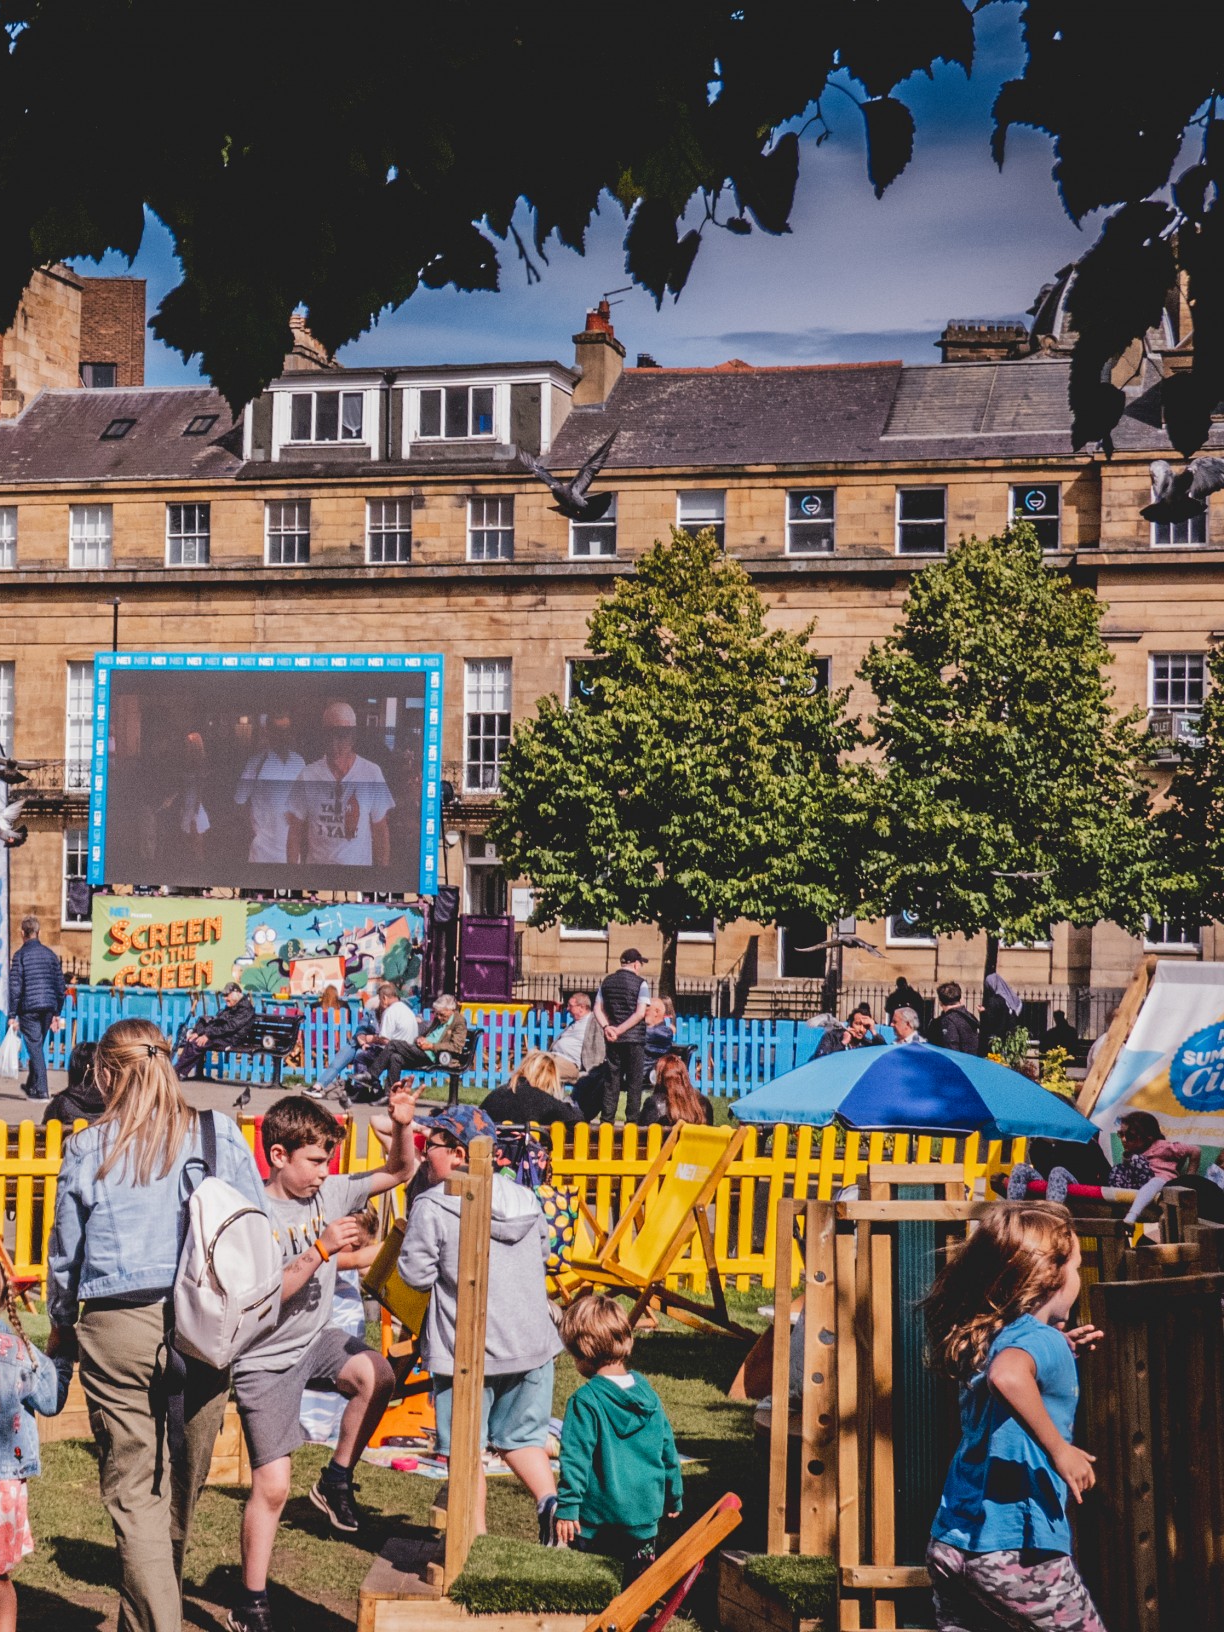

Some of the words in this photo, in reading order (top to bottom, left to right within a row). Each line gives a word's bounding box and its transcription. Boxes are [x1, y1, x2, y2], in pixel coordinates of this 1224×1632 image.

[116, 656, 131, 665] NE1
[151, 657, 166, 665] NE1
[187, 657, 202, 666] NE1
[222, 657, 238, 666] NE1
[258, 658, 274, 666] NE1
[294, 658, 310, 666] NE1
[331, 658, 346, 666] NE1
[368, 658, 383, 667] NE1
[405, 658, 420, 667] NE1
[109, 907, 130, 917] NE1
[109, 915, 222, 955] SCREEN
[140, 949, 165, 965] ON
[168, 946, 196, 962] THE
[114, 960, 213, 989] GREEN
[675, 1162, 697, 1181] NE1
